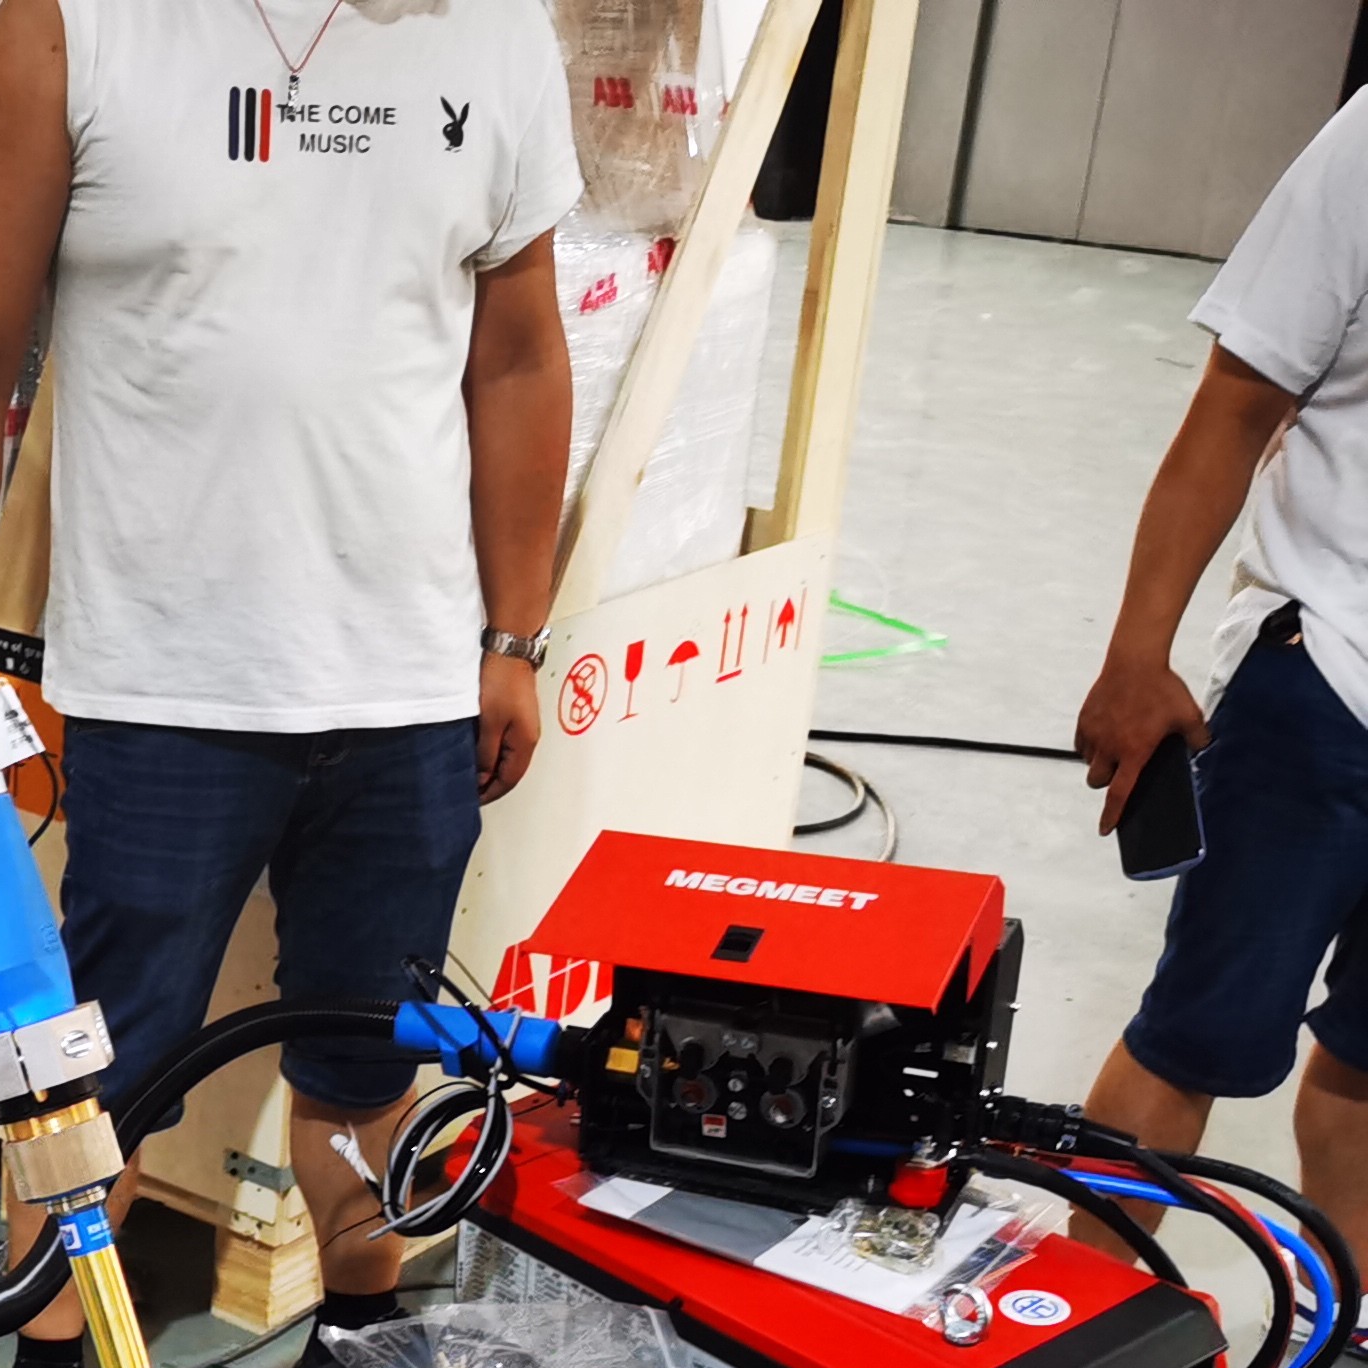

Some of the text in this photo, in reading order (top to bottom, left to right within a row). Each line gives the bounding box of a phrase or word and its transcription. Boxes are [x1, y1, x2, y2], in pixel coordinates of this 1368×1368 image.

[594, 76, 636, 109] ABB
[328, 104, 397, 125] COME
[299, 133, 371, 154] MUSIC
[664, 869, 880, 911] MEGMEET
